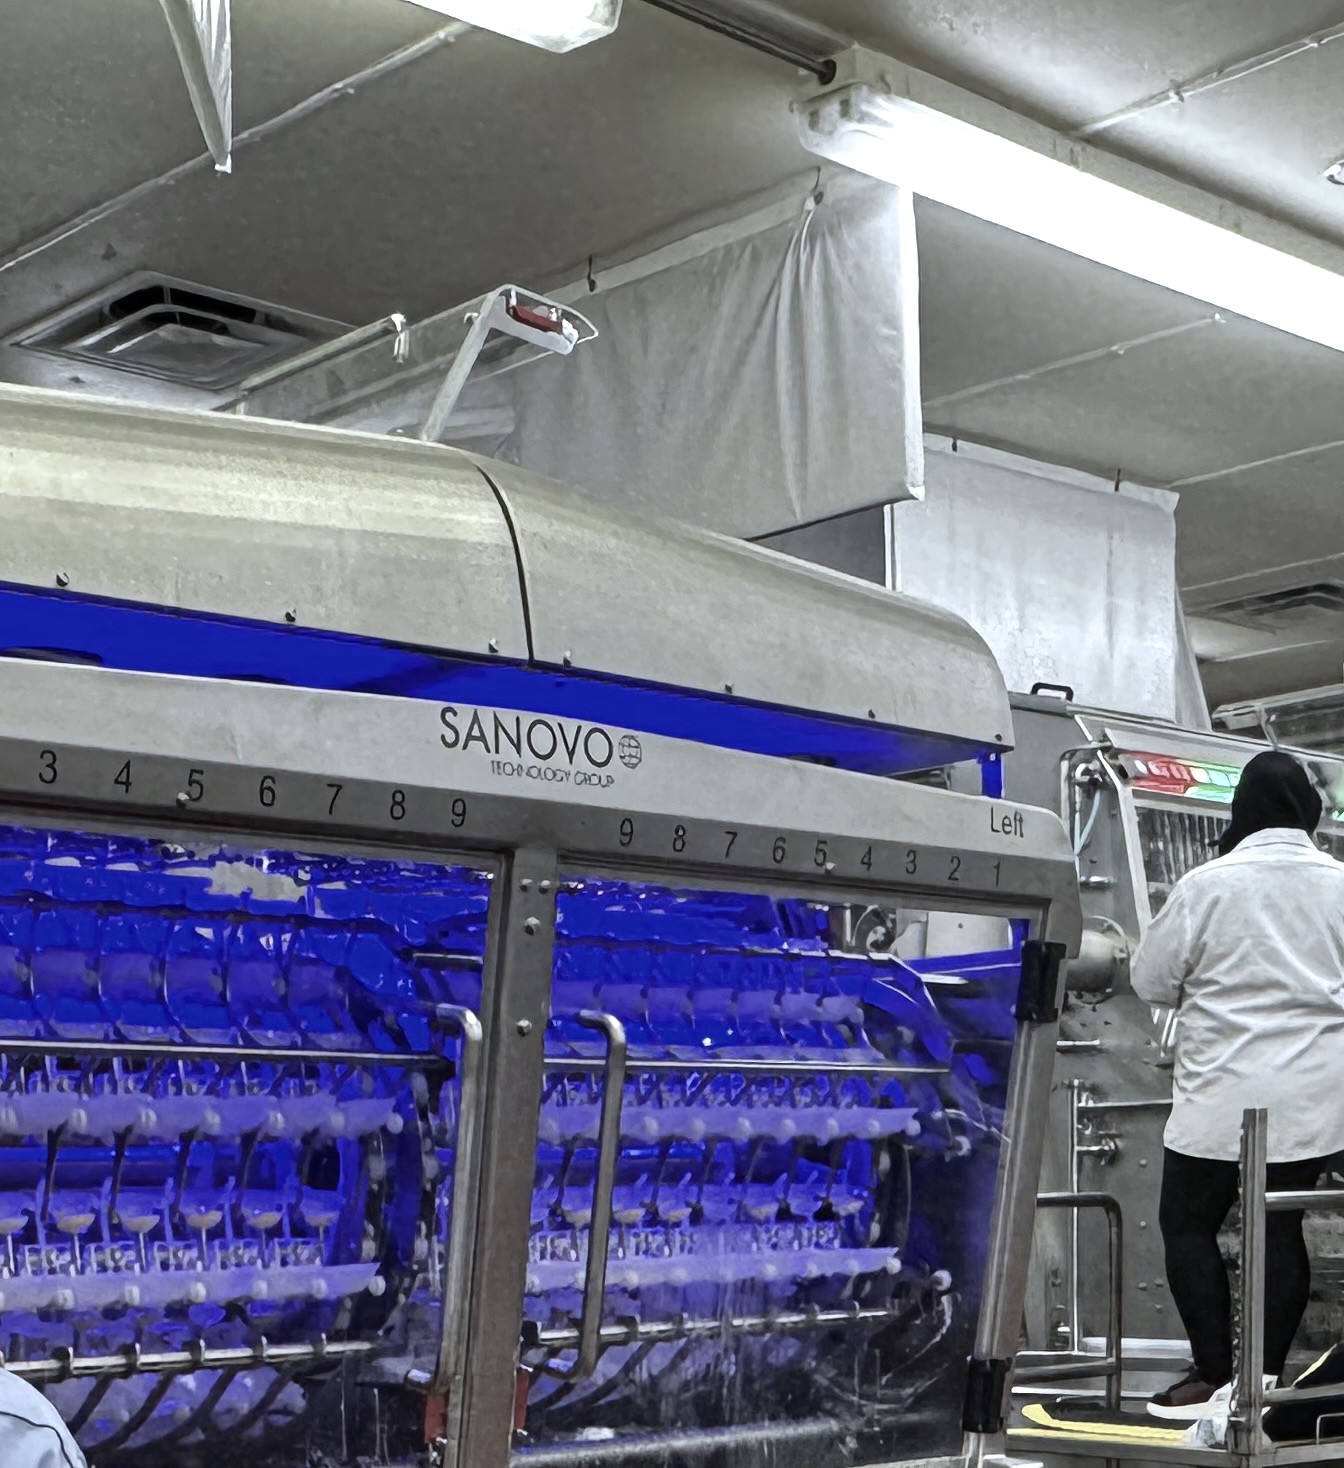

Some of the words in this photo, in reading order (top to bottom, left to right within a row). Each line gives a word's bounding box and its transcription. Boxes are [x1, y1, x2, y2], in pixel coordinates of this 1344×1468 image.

[440, 706, 614, 768] SANOVO
[38, 749, 58, 785] 3
[113, 759, 133, 794] 4
[186, 768, 205, 802] 5
[259, 775, 276, 808] 6
[326, 783, 343, 816] 7
[389, 789, 406, 821] 8
[450, 798, 467, 828] 9
[619, 817, 634, 848] 9
[672, 824, 687, 853] 8
[724, 830, 738, 859] 7
[772, 836, 787, 864] 6
[813, 838, 829, 867] 5
[860, 845, 873, 872] 4
[905, 849, 917, 875] 3
[947, 855, 961, 882] 2
[993, 861, 1001, 887] 1
[990, 806, 1024, 838] Left
